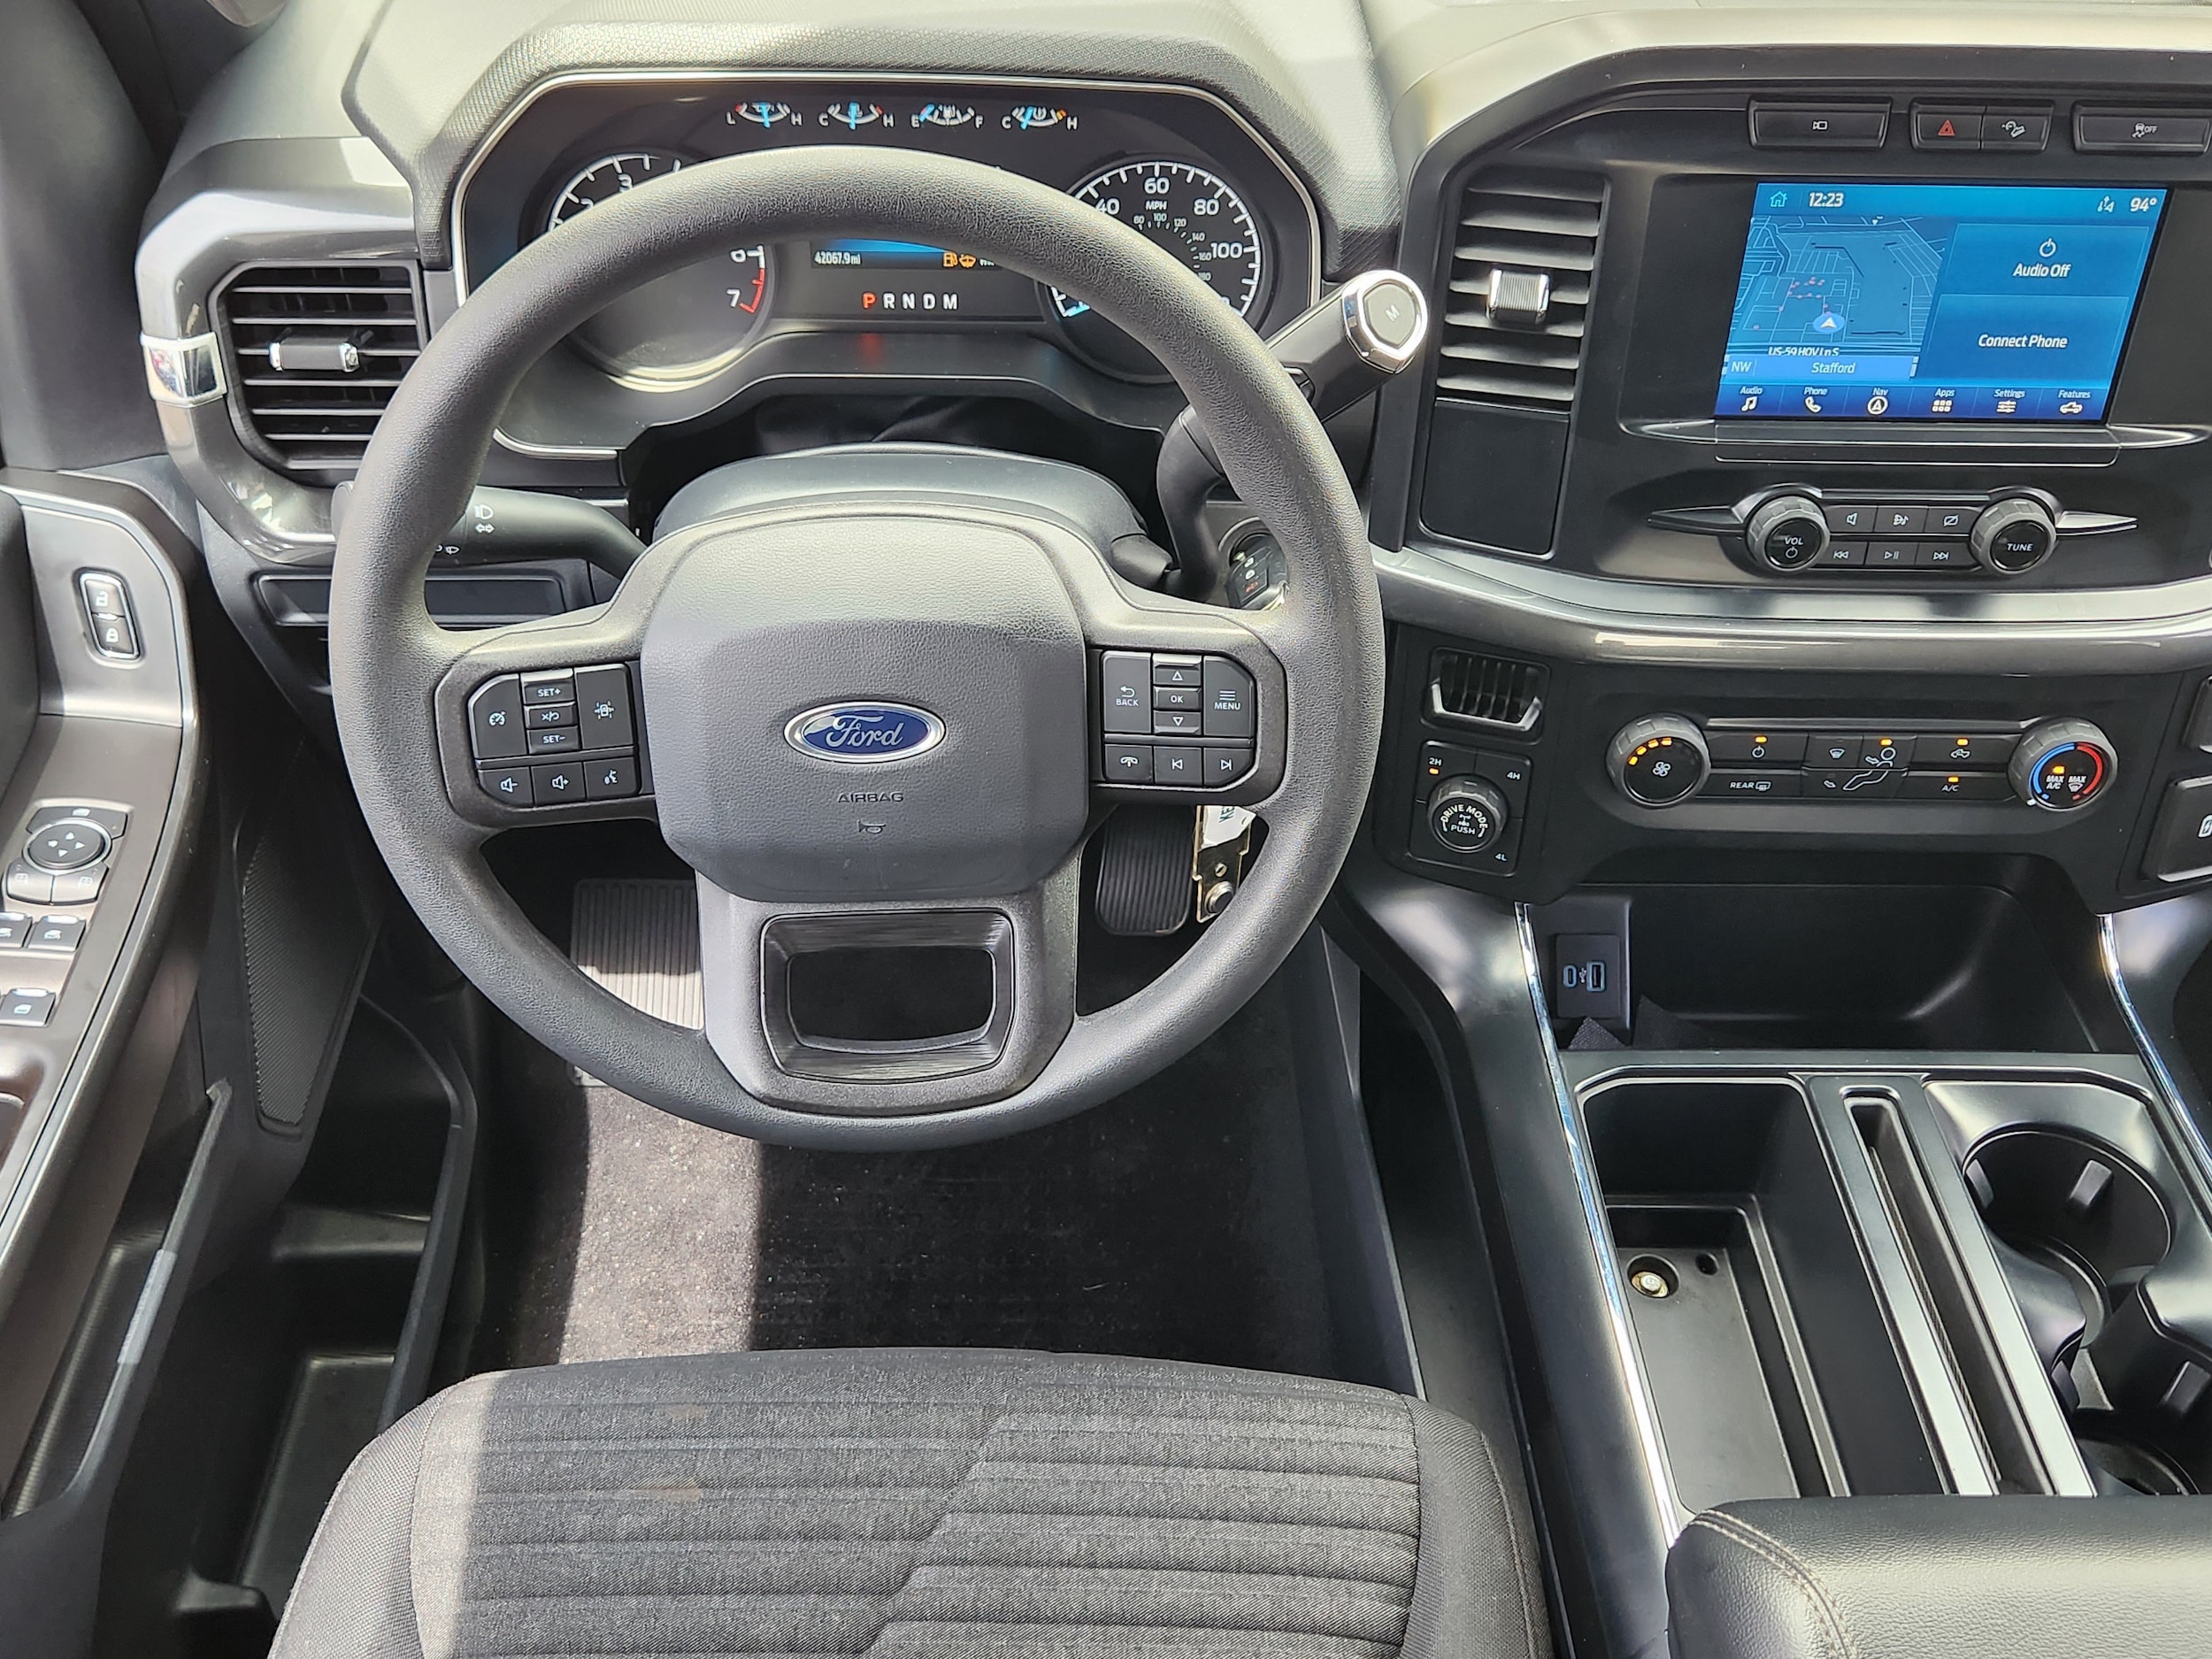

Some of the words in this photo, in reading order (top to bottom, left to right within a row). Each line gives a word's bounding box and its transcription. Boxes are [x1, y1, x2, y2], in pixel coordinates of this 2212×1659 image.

[726, 112, 735, 125] L
[790, 112, 802, 126] H
[818, 114, 829, 127] C
[883, 114, 894, 127] H
[911, 116, 920, 128] E
[976, 116, 984, 129] F
[1002, 115, 1011, 129] C
[1067, 118, 1078, 130] H
[1144, 177, 1170, 194] 60
[1095, 197, 1120, 215] 40
[1146, 200, 1167, 211] MPH
[1809, 192, 1844, 207] 12:23
[1194, 199, 1219, 215] 80
[1173, 219, 1187, 227] 120
[1192, 233, 1205, 242] 140
[1199, 252, 1212, 261] 160
[1210, 242, 1243, 258] 100
[2013, 264, 2049, 277] Audio
[2050, 265, 2071, 277] Off
[726, 288, 741, 307] 7
[863, 293, 876, 308] P
[883, 294, 895, 309] R
[902, 294, 915, 309] N
[923, 294, 935, 309] D
[943, 294, 957, 310] M
[1978, 334, 2027, 348] Connect
[2028, 334, 2068, 349] Phone
[1732, 361, 1752, 373] NW
[1811, 362, 1855, 373] Stafford
[1803, 387, 1828, 396] Phone
[1872, 388, 1889, 396] Nav
[1935, 388, 1955, 398] Apps
[1993, 389, 2025, 399] Settings
[2058, 390, 2091, 399] Features
[2007, 542, 2033, 551] TUNE
[1116, 698, 1139, 707] BACK
[1214, 702, 1240, 710] MENU
[826, 714, 904, 747] Ford
[1429, 757, 1442, 766] 2H
[1506, 772, 1521, 780] 4H
[837, 792, 903, 803] AIRBAG
[1440, 804, 1465, 823] DRIVE
[1466, 805, 1488, 829] MODE
[1450, 824, 1476, 835] PUSH
[1495, 853, 1508, 862] 4L
